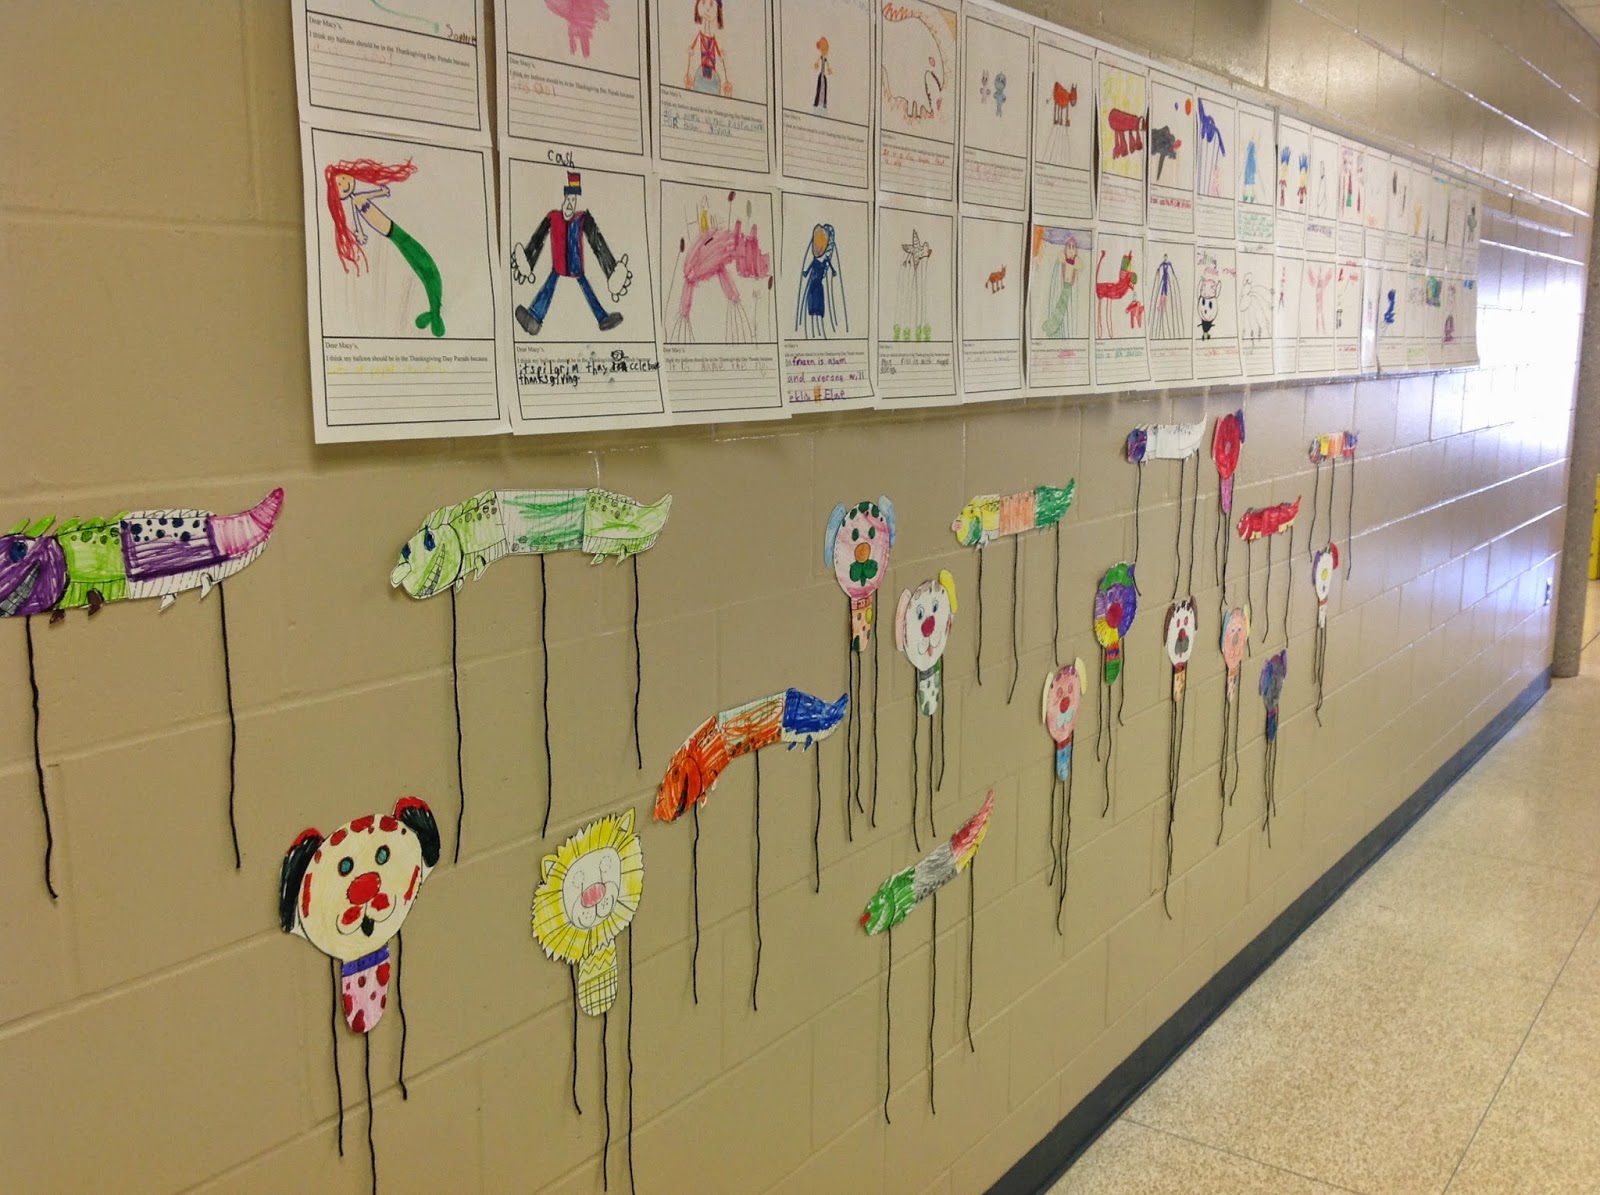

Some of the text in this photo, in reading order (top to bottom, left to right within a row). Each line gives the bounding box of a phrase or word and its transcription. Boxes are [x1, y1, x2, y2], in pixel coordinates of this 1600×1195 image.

[356, 40, 373, 48] should
[409, 355, 441, 363] Thanksgiving
[442, 355, 452, 363] Day
[788, 372, 805, 383] and
